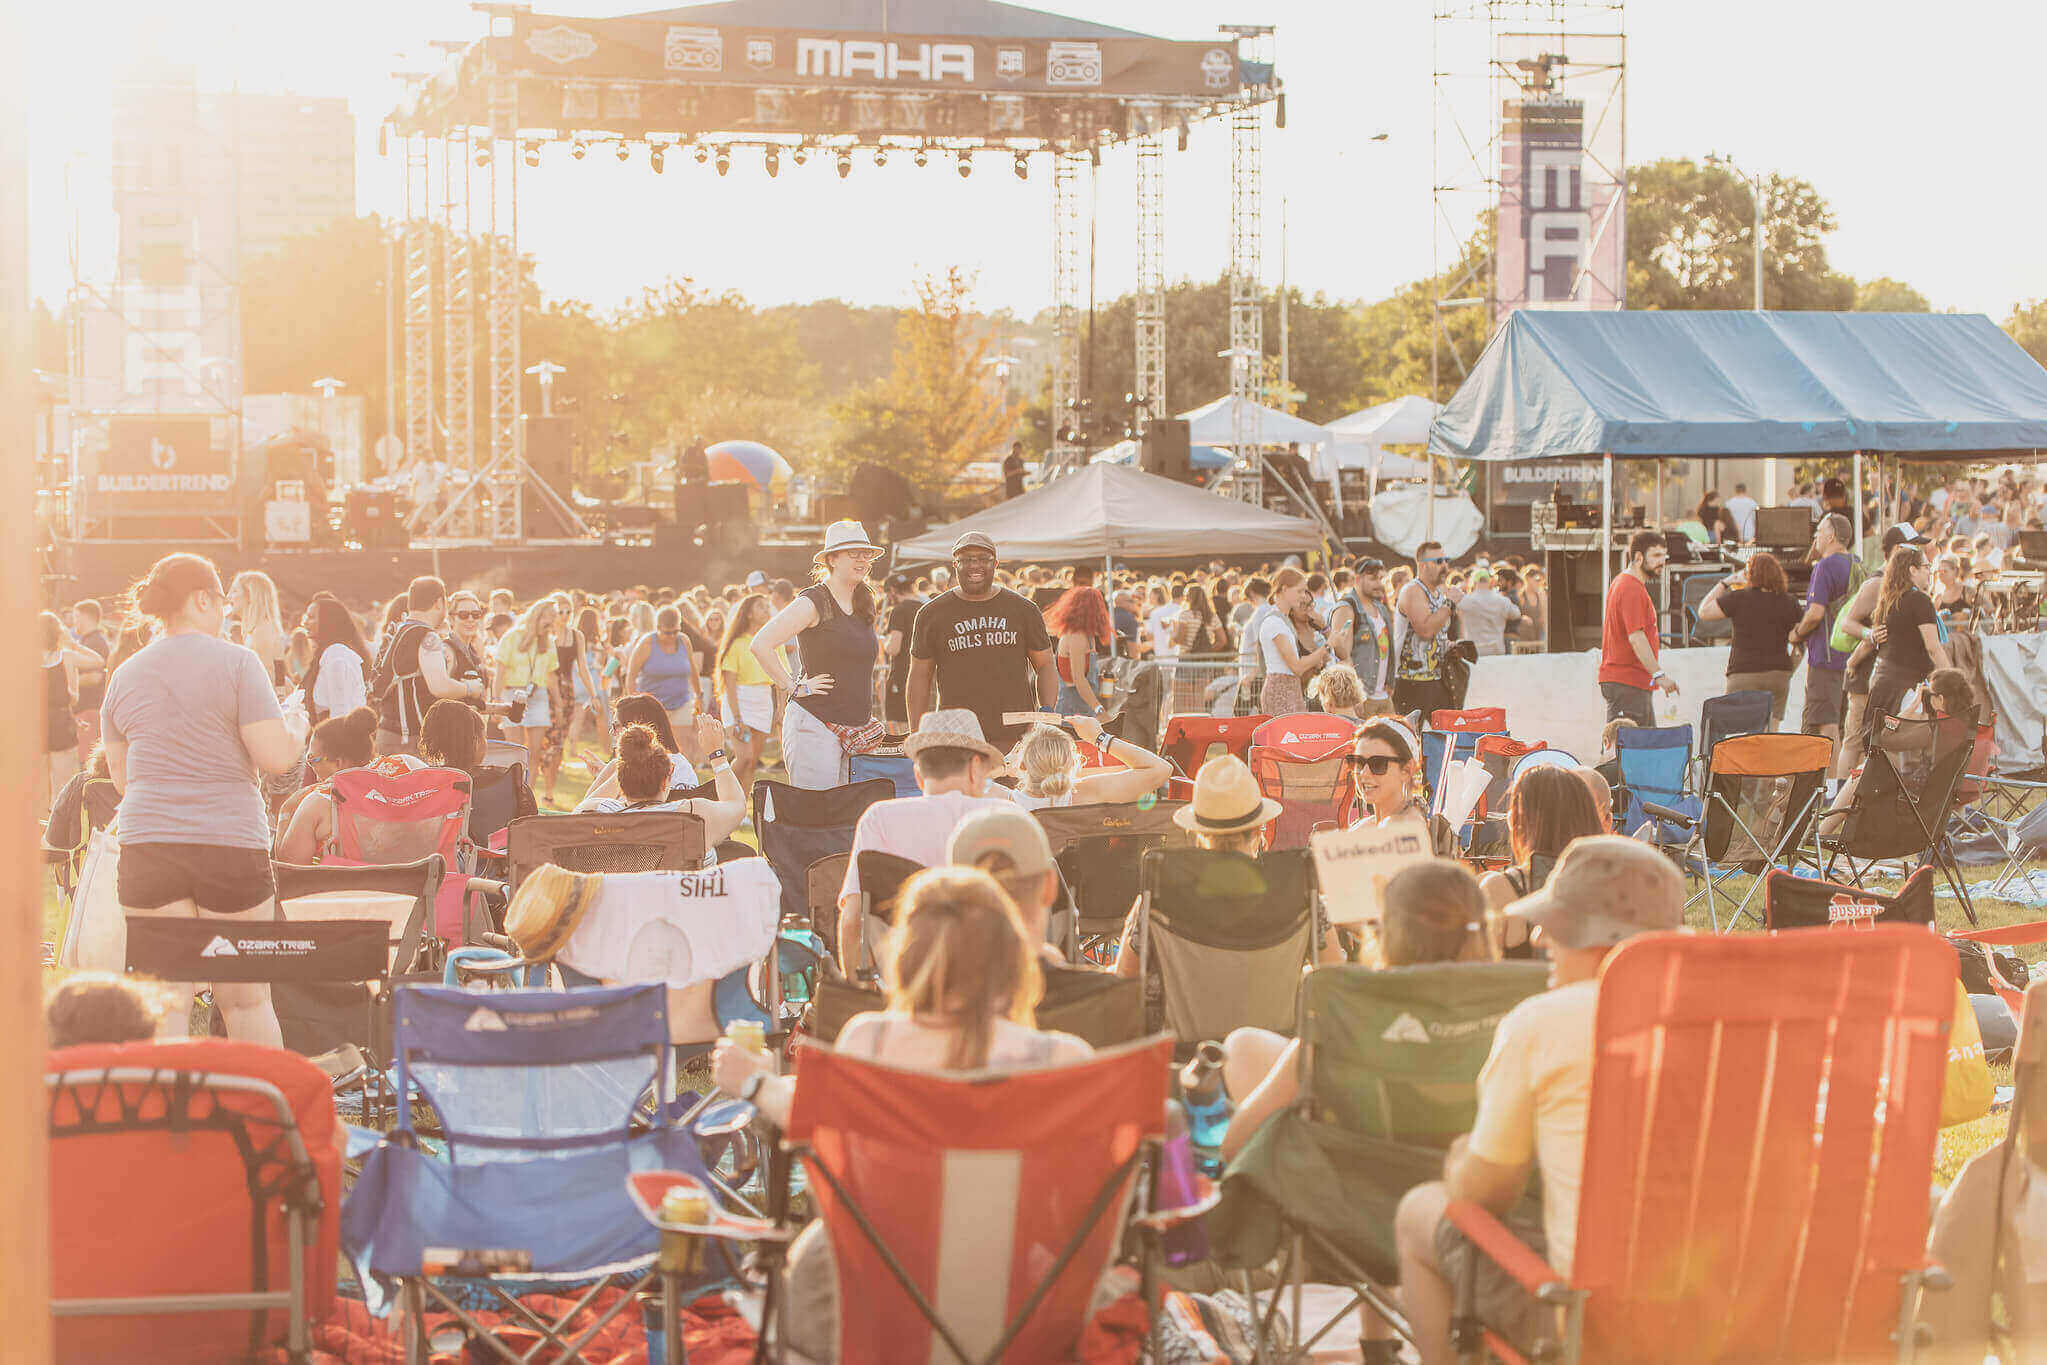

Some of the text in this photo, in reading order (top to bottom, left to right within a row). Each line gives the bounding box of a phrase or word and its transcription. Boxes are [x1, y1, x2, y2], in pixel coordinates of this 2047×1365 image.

[797, 37, 974, 82] MAHA
[97, 474, 230, 491] BUILDERTREND
[1504, 466, 1603, 482] BUILDERTREN
[954, 616, 1007, 635] OMAHA
[948, 631, 1017, 652] GIRLS ROCK
[237, 939, 317, 950] OZARK TRAIL
